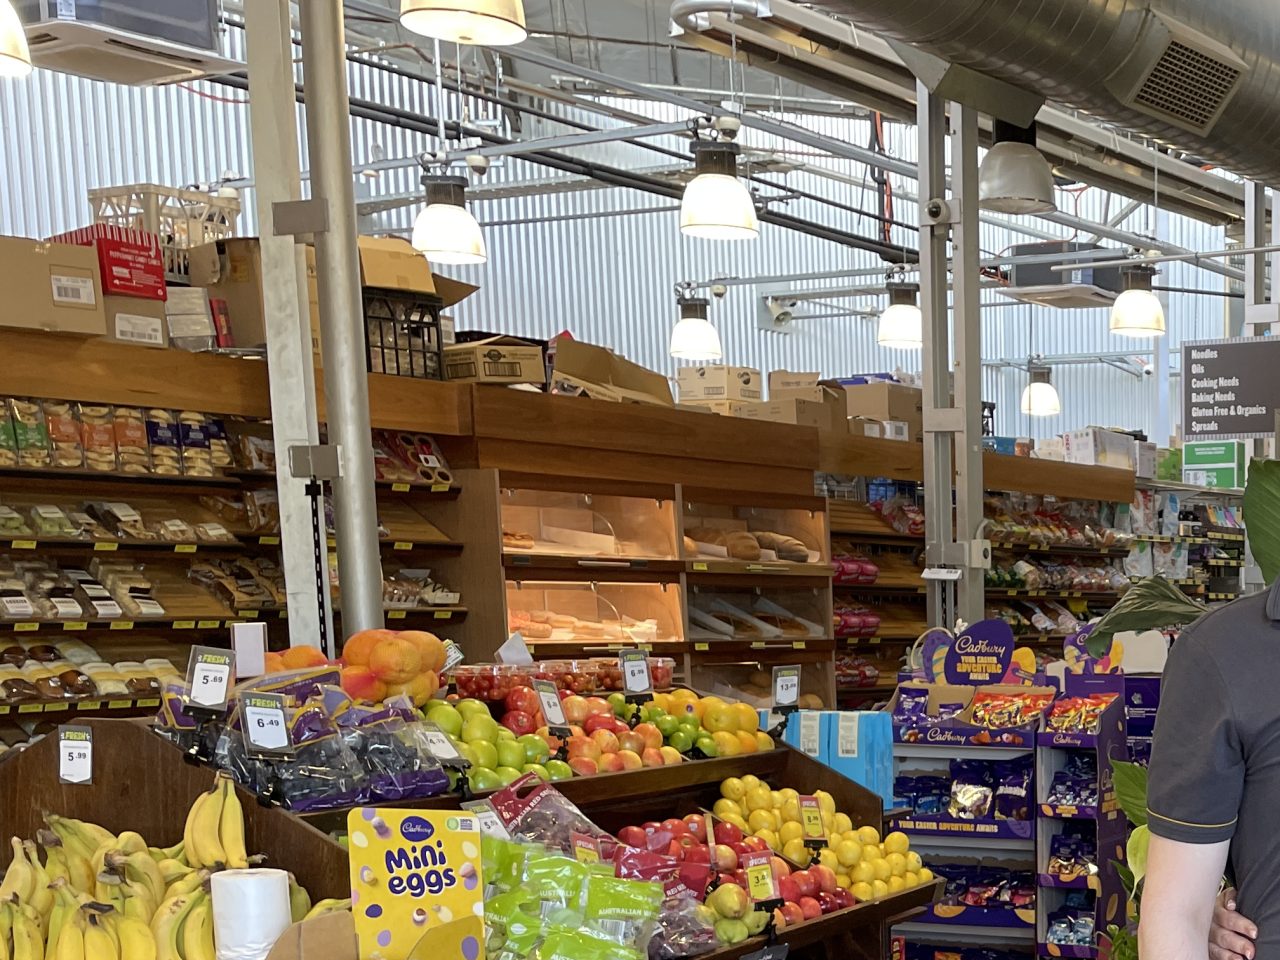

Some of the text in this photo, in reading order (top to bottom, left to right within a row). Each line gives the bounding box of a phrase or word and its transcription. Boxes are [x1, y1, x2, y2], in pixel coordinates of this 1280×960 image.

[1191, 349, 1218, 360] Noodles
[1191, 364, 1205, 374] Oils
[1191, 376, 1240, 390] Cooking Needs
[1191, 391, 1236, 404] Baking Needs
[1191, 404, 1266, 417] Gluten Free & Organics
[1191, 420, 1218, 432] Spreads
[955, 636, 1006, 658] Cadbury
[202, 654, 226, 664] FRESH
[251, 698, 276, 708] FRESH
[66, 731, 86, 740] FRESH
[926, 727, 966, 744] Cadbury
[1053, 734, 1082, 746] Cadbury
[402, 822, 432, 836] Cadbury
[385, 840, 446, 874] Mini
[388, 868, 456, 898] eggs
[598, 908, 642, 916] AUSTRALIAN
